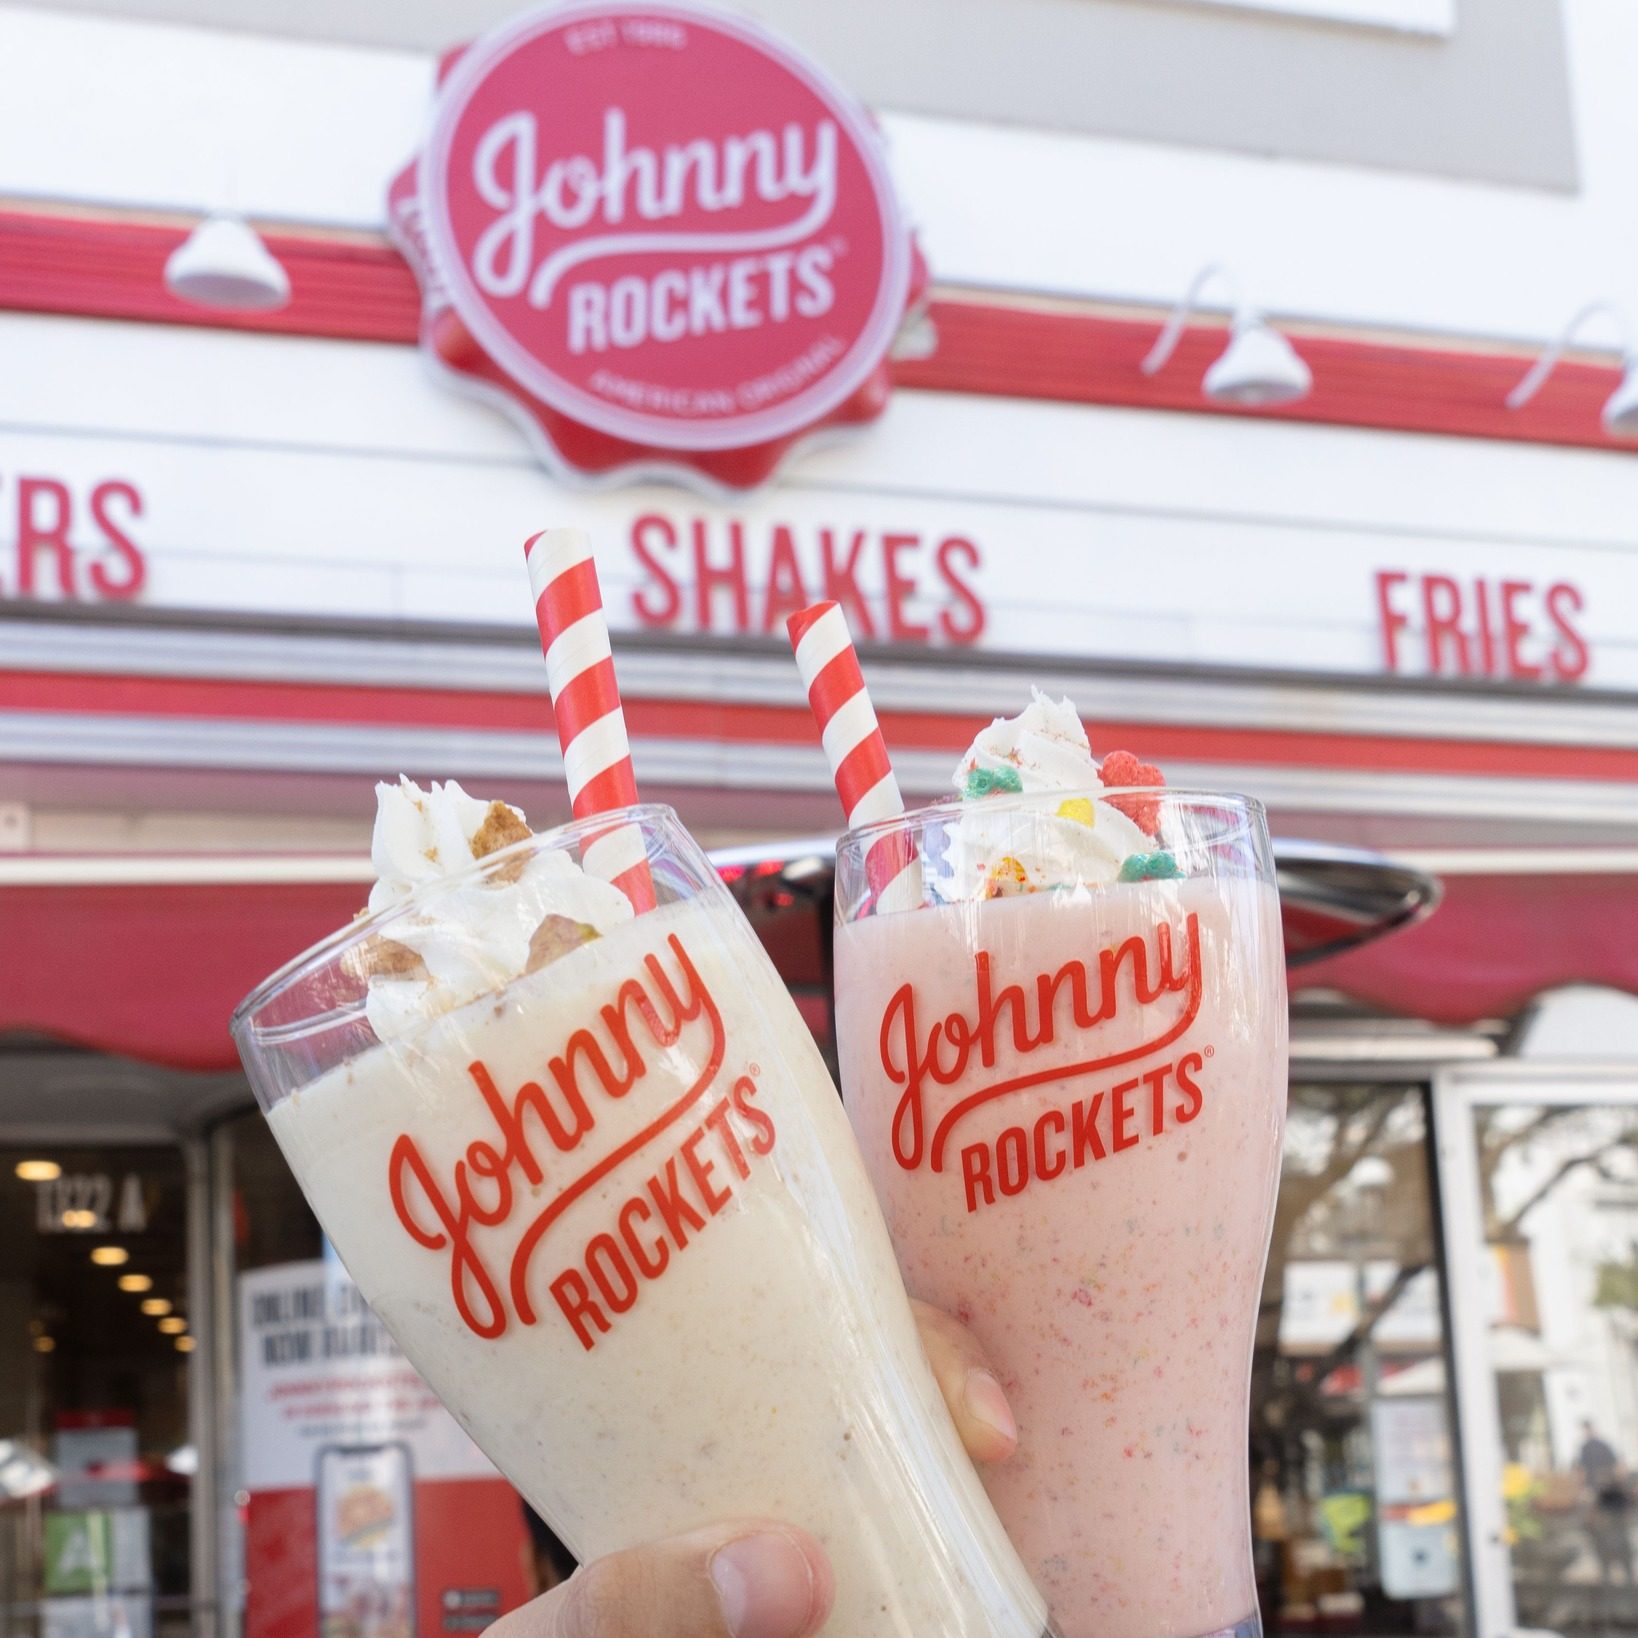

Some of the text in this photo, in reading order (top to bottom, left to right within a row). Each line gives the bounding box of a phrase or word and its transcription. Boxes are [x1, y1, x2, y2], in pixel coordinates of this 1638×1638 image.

[473, 107, 838, 309] Johnny
[631, 514, 986, 644] SHAKES
[1376, 570, 1589, 682] FRIES
[388, 933, 727, 1340] Johnny
[880, 912, 1203, 1173] Johnny
